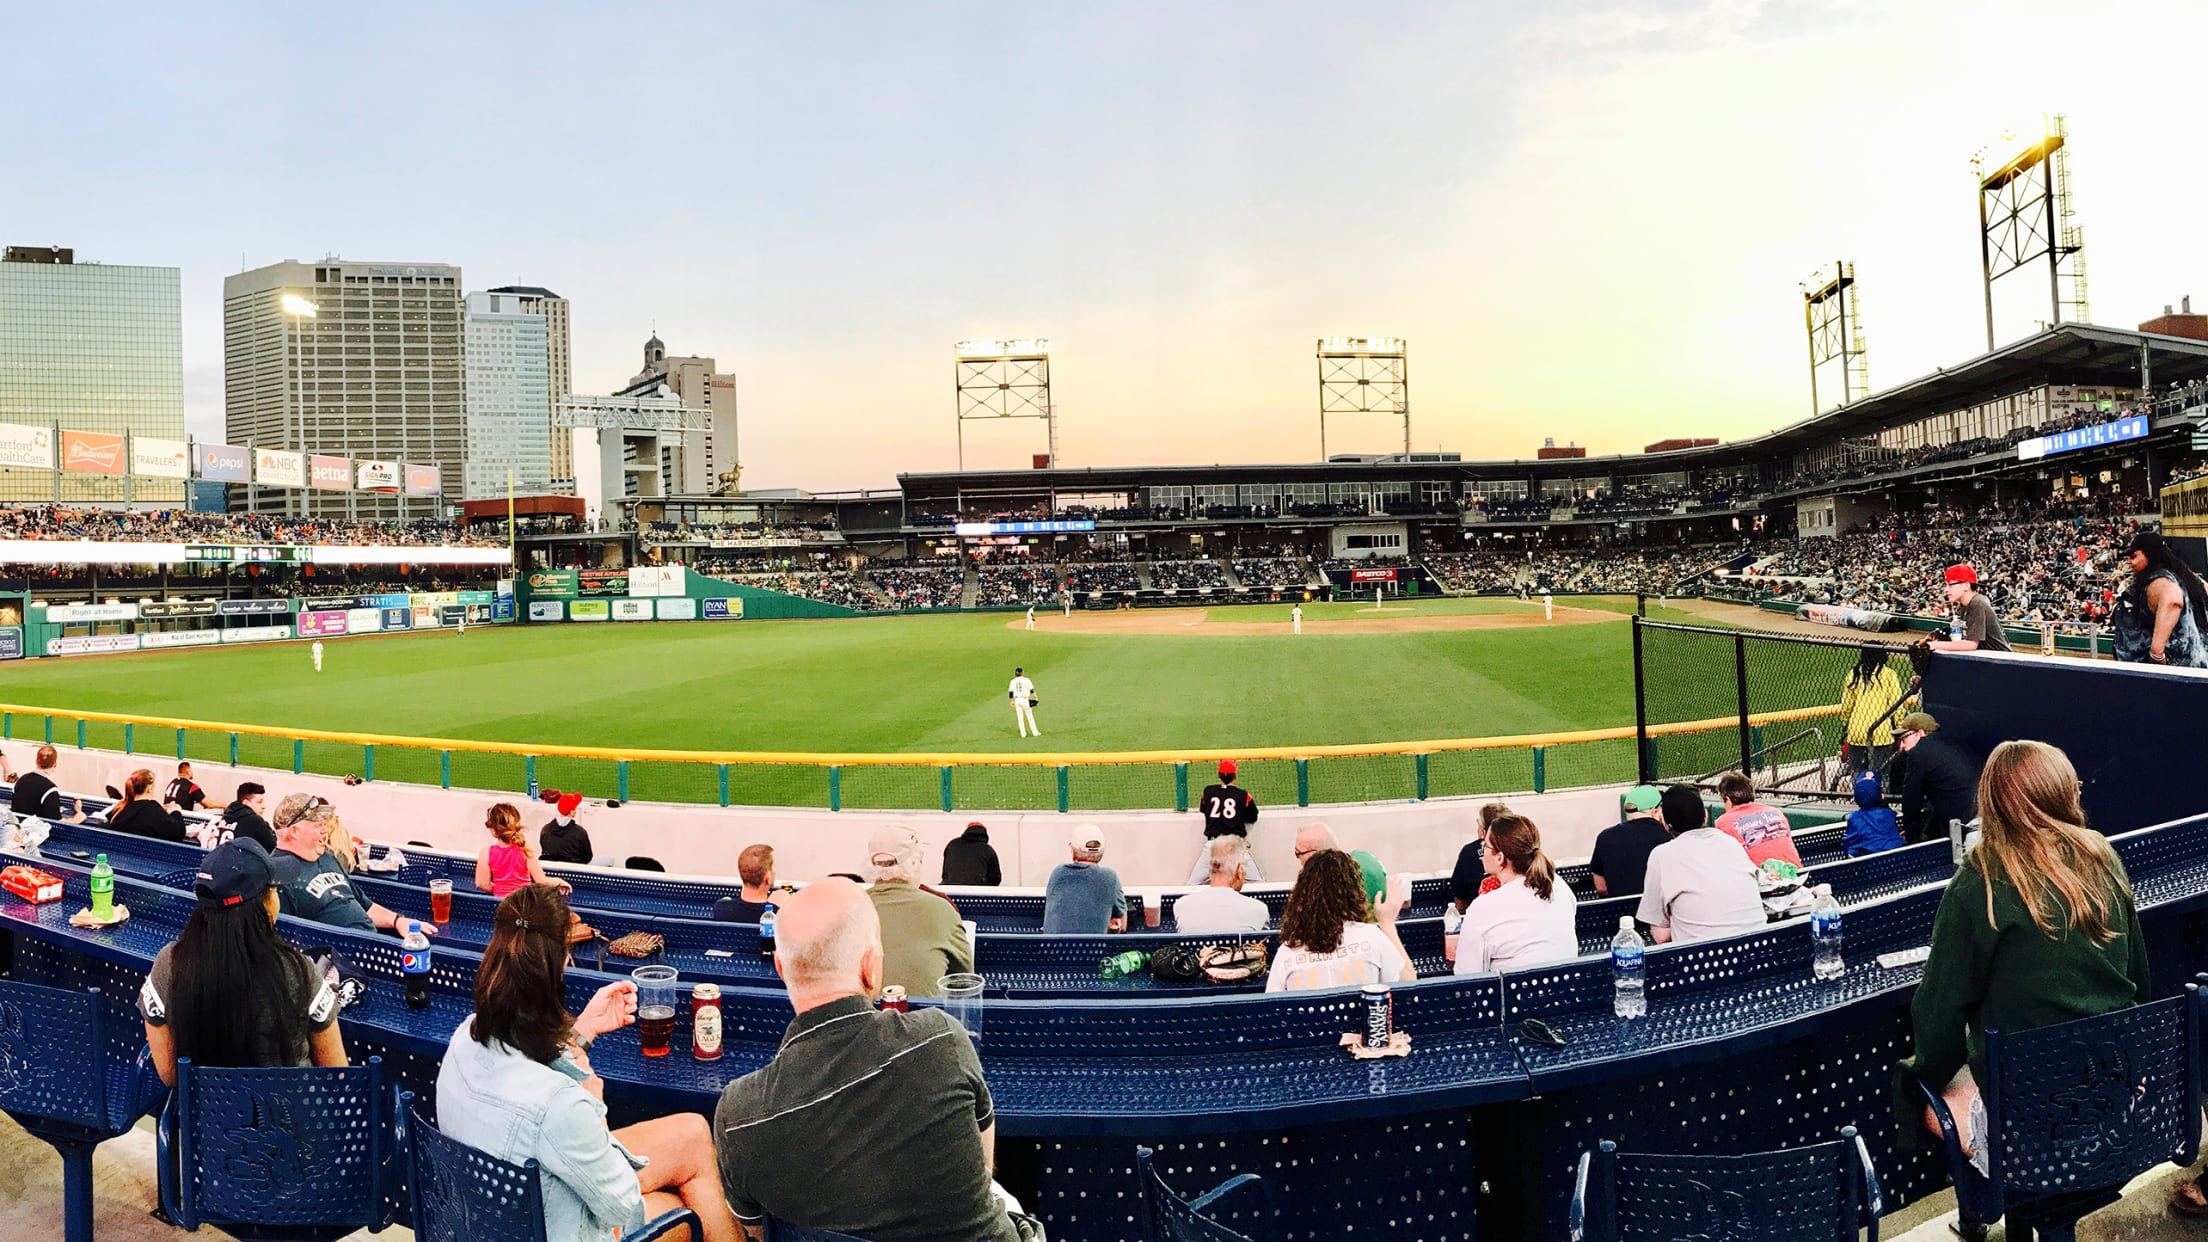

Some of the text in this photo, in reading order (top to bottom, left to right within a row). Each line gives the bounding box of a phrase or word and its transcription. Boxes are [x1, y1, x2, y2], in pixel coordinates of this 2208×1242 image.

[135, 454, 177, 467] TRAVELERS
[219, 457, 244, 470] pepsi
[276, 457, 298, 471] NBC
[312, 466, 348, 482] aetna
[379, 472, 393, 480] PRO
[705, 601, 727, 609] RYAN
[71, 608, 92, 617] Right
[165, 782, 181, 798] 41
[1209, 796, 1237, 819] 28
[1284, 942, 1371, 969] HORNETS
[1616, 957, 1643, 967] AQUAFINA
[1368, 1001, 1381, 1048] SAMUEL
[1379, 1004, 1388, 1042] ADAMS
